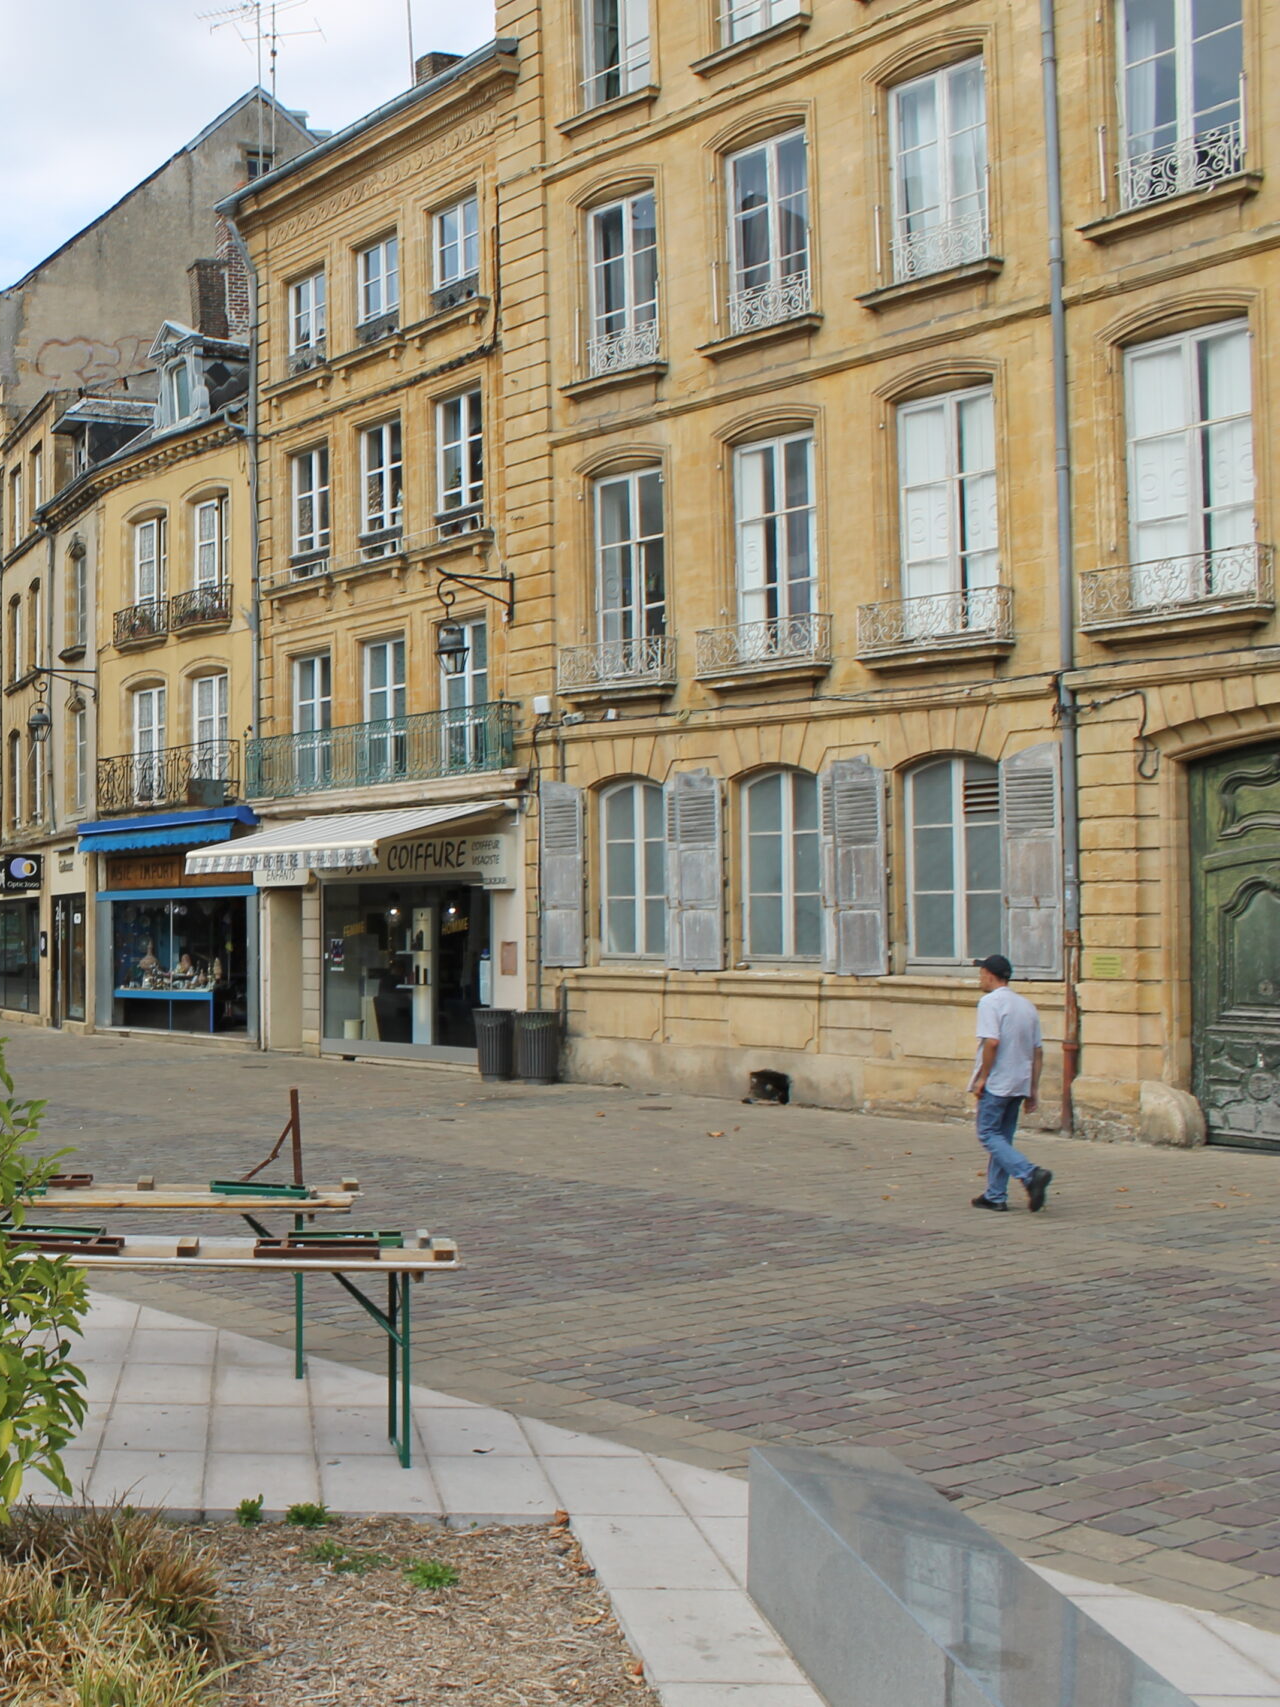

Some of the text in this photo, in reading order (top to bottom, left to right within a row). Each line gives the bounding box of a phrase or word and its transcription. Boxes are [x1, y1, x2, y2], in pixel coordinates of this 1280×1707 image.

[471, 840, 500, 851] COIFFEUR
[263, 853, 298, 869] COIFFURE
[387, 840, 466, 871] COIFFURE
[141, 862, 174, 880] IMPORT
[266, 869, 296, 882] ENFANTS
[441, 917, 469, 935] HOMME
